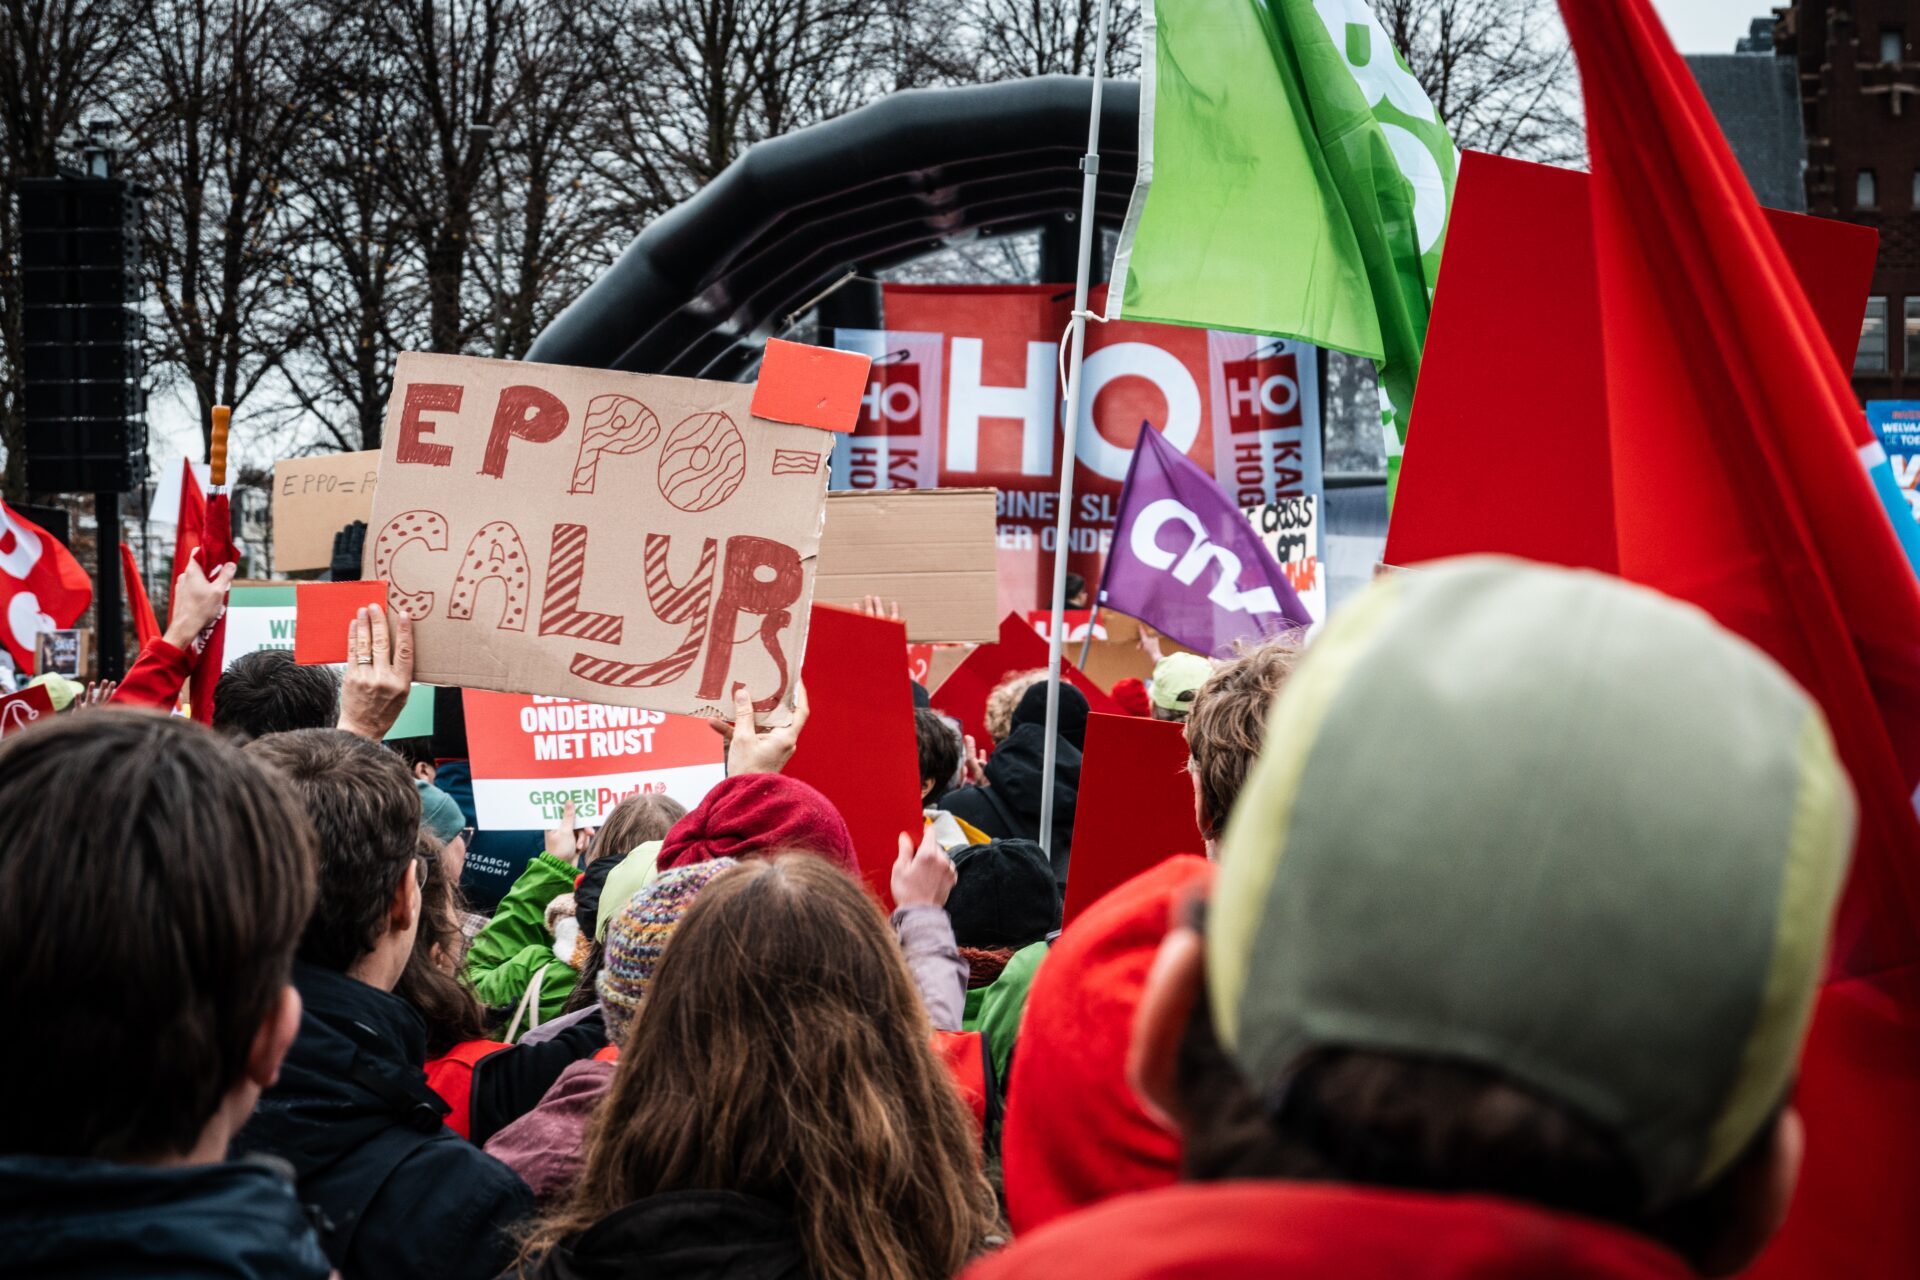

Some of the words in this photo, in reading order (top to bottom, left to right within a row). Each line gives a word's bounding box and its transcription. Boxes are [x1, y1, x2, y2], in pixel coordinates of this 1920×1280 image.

[946, 336, 1201, 481] HO
[1229, 374, 1299, 417] HO
[534, 733, 587, 761] MET
[590, 727, 655, 758] RUST
[529, 789, 597, 805] GROEN
